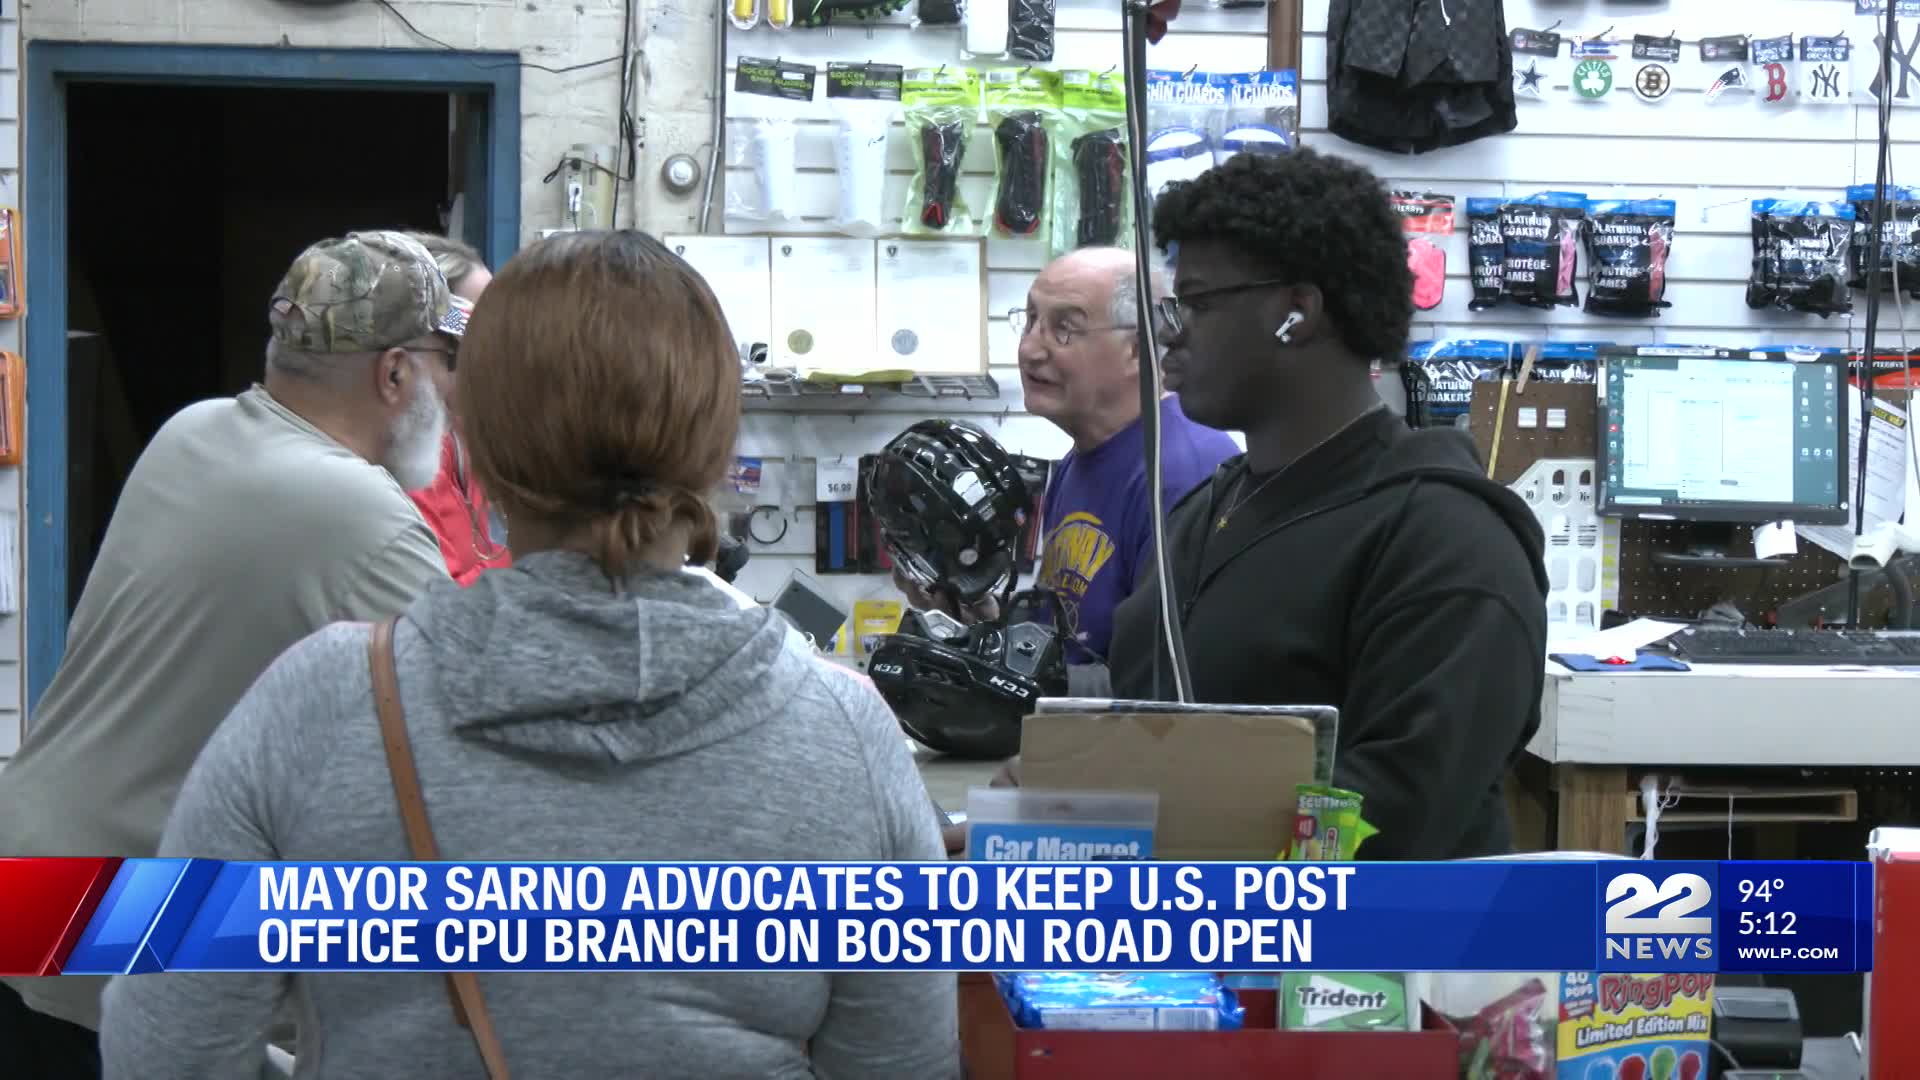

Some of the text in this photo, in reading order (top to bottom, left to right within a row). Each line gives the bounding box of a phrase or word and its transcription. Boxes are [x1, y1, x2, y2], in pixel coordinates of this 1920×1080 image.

[985, 835, 1034, 860] Car
[1297, 986, 1386, 1009] Trident
[1577, 1014, 1708, 1048] Limited Edition Mix
